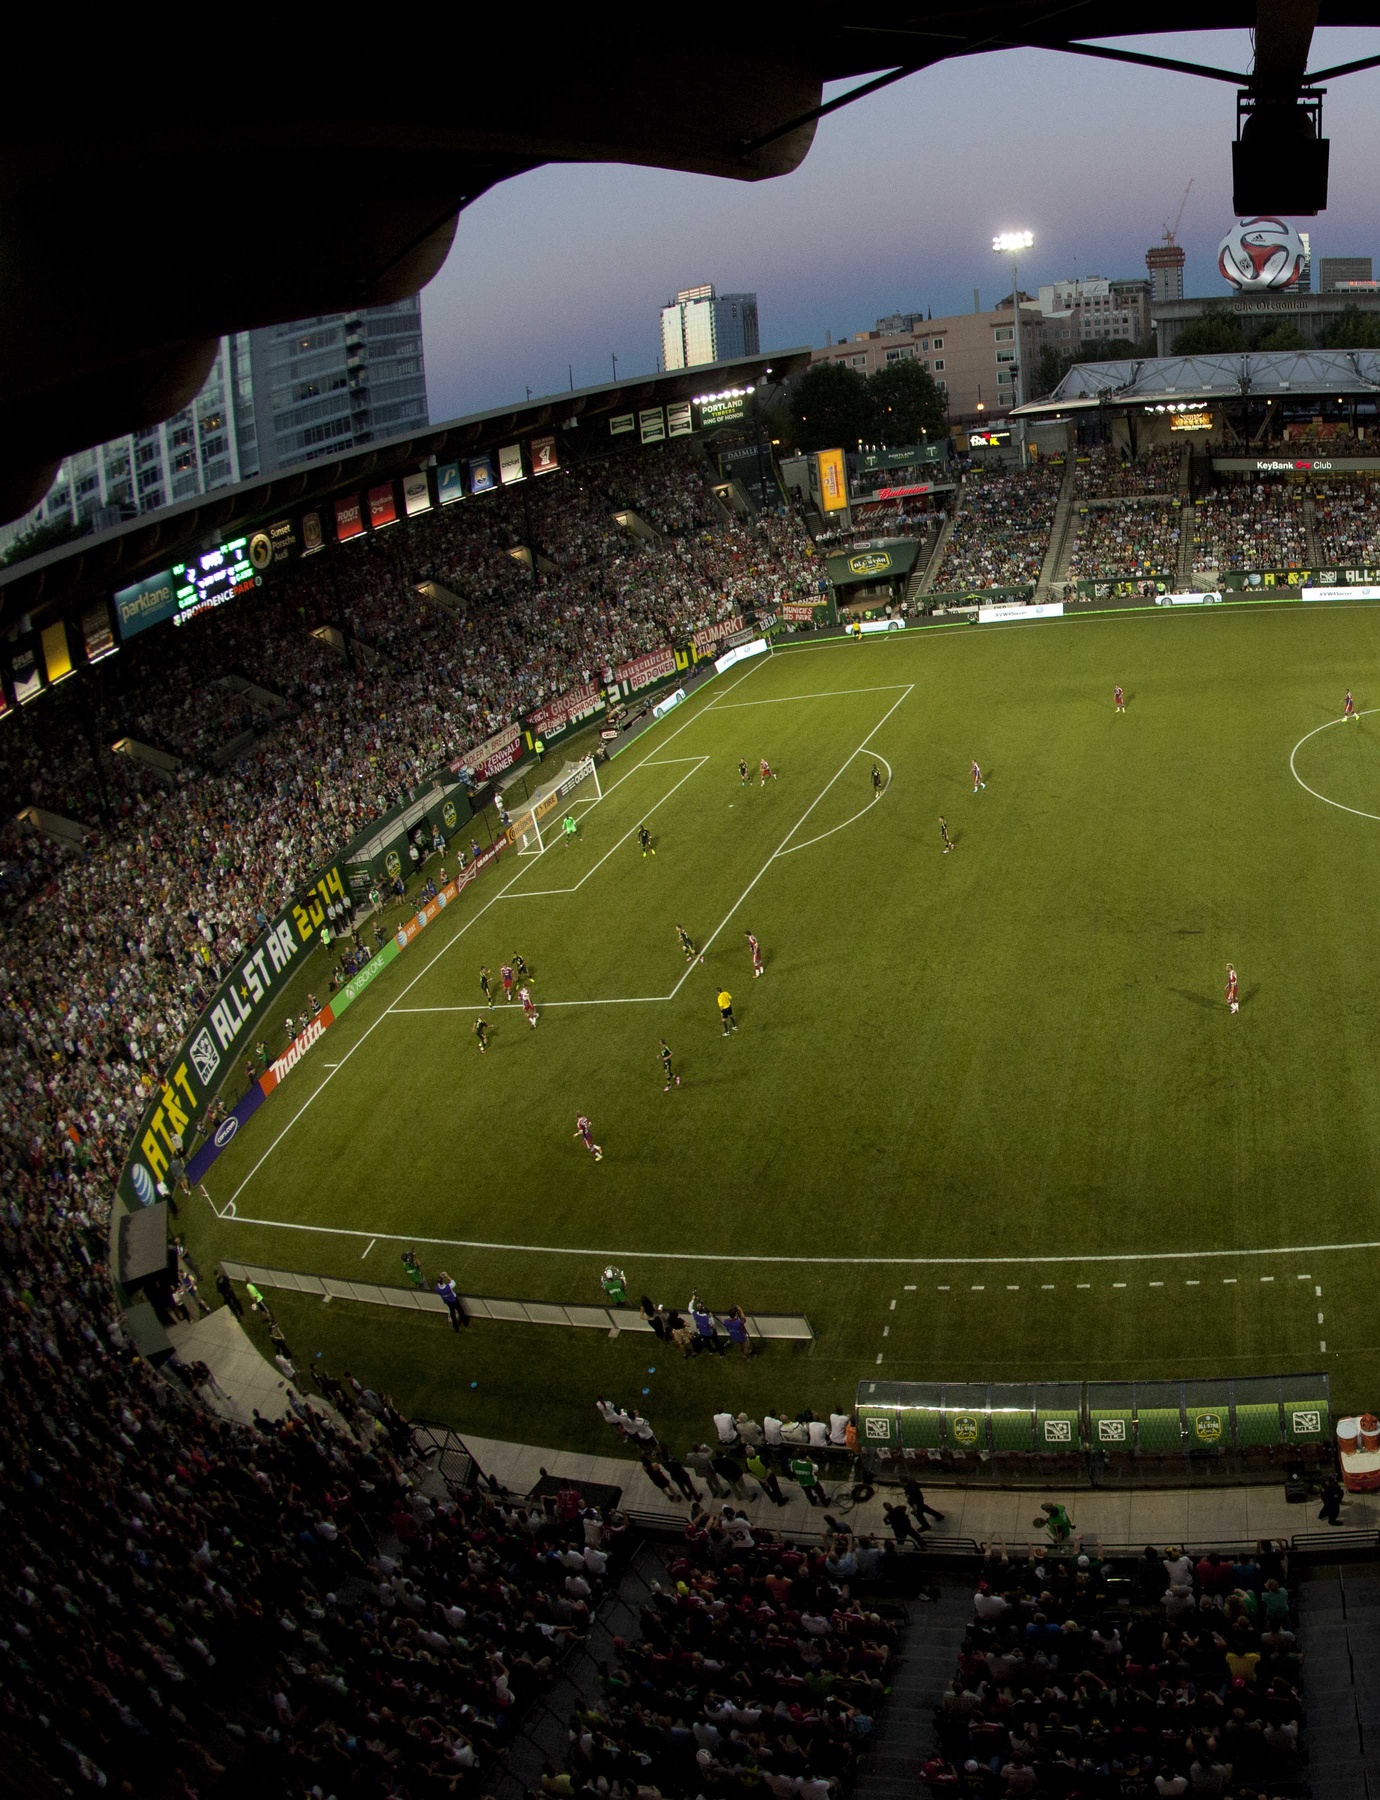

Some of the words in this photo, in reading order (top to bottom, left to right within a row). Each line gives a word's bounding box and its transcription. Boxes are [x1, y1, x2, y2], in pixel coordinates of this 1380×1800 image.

[1233, 301, 1253, 311] The
[1255, 300, 1309, 311] Oregonian
[702, 400, 743, 414] PORTLAND
[711, 408, 736, 417] TIMBERS
[703, 417, 717, 426] RING
[724, 412, 744, 421] HONOR
[727, 448, 759, 460] DAIMLE
[1257, 461, 1294, 470] KeyBank
[1313, 461, 1332, 469] Club
[878, 485, 929, 500] Budweiser
[337, 506, 361, 521] ROOT
[270, 525, 291, 538] Sunset
[271, 535, 297, 550] Porsche
[121, 587, 171, 624] parklane
[180, 588, 235, 622] PROVIDENCE
[233, 578, 256, 597] PARK
[692, 615, 744, 649] NEUMARKT
[632, 673, 647, 688] RED
[646, 661, 675, 681] POWER
[491, 725, 519, 751] BRETTEN
[353, 966, 373, 992] XBOX
[370, 955, 386, 977] ONE
[140, 1061, 198, 1182] AT&T
[216, 1120, 236, 1144] cars.com
